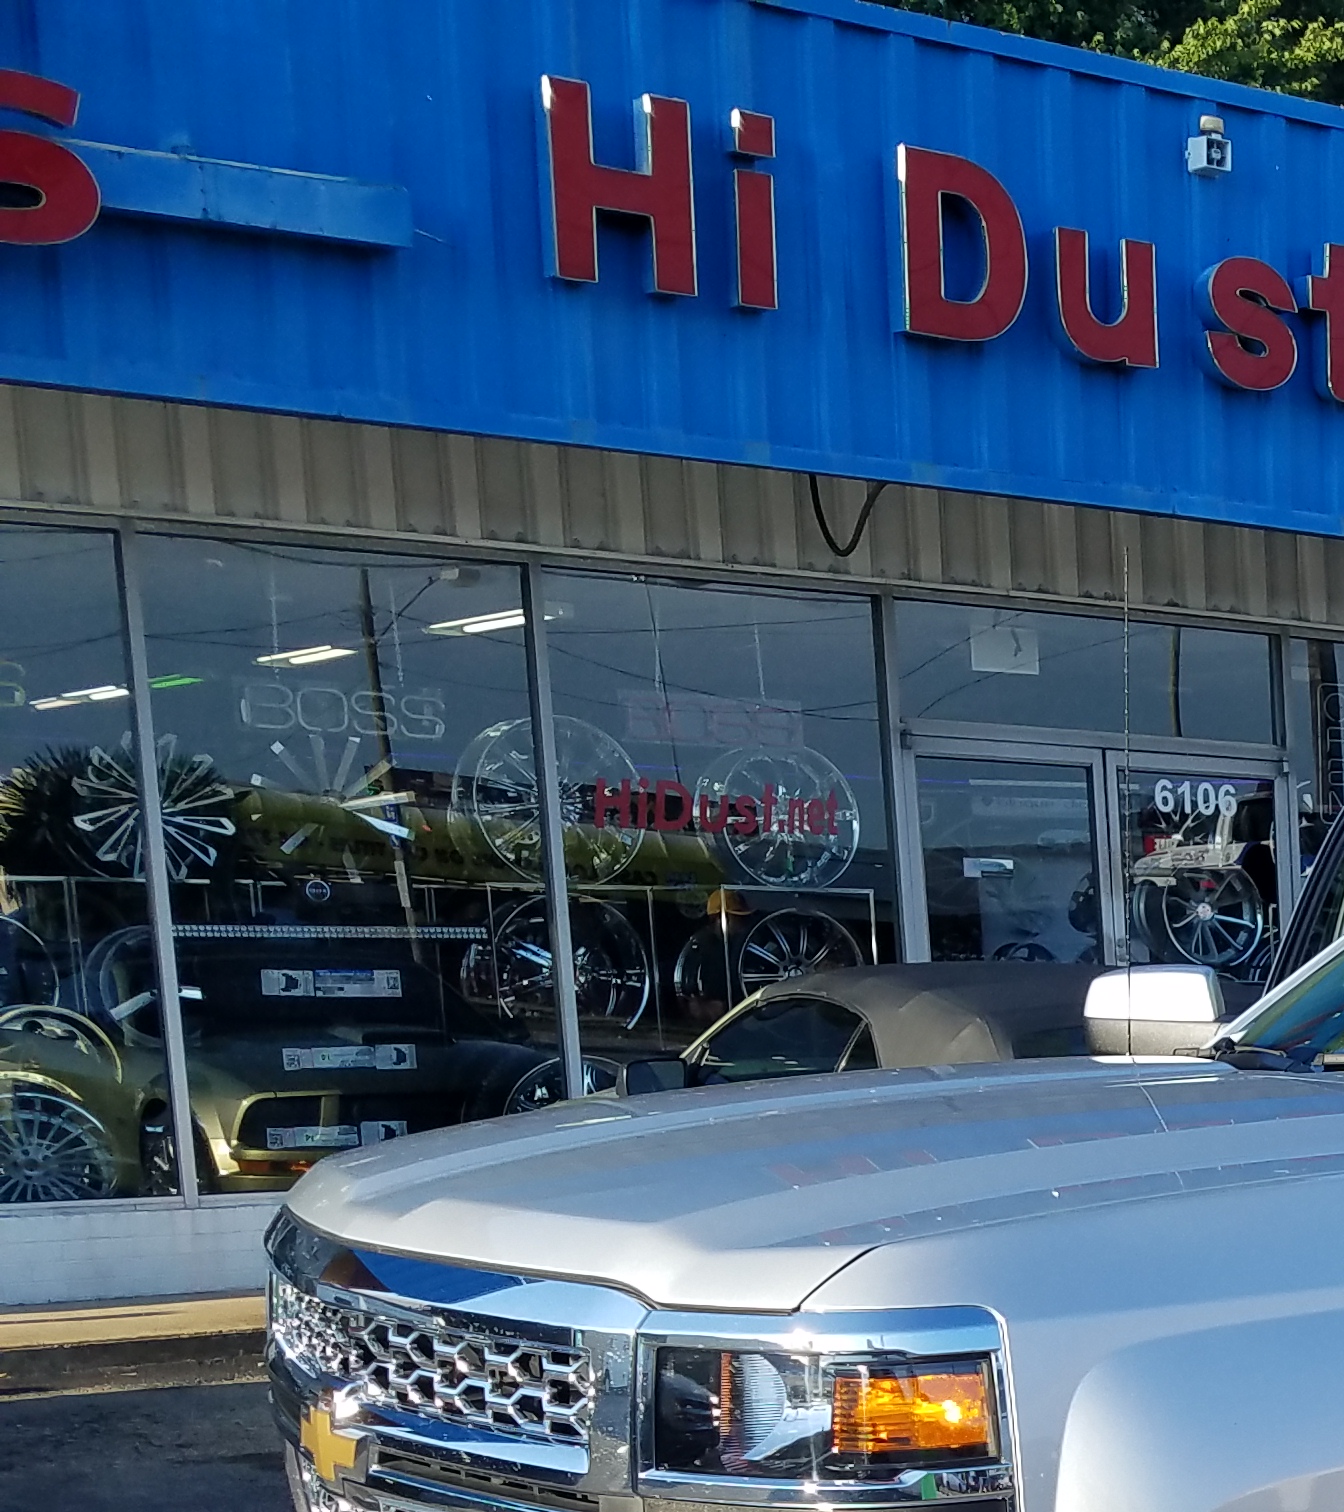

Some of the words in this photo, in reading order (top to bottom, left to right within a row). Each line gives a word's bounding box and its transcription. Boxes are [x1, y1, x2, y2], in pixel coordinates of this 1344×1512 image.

[540, 74, 779, 311] Hi
[241, 683, 447, 739] BOSS
[594, 778, 839, 836] HiDust.net
[1154, 779, 1238, 817] 6106
